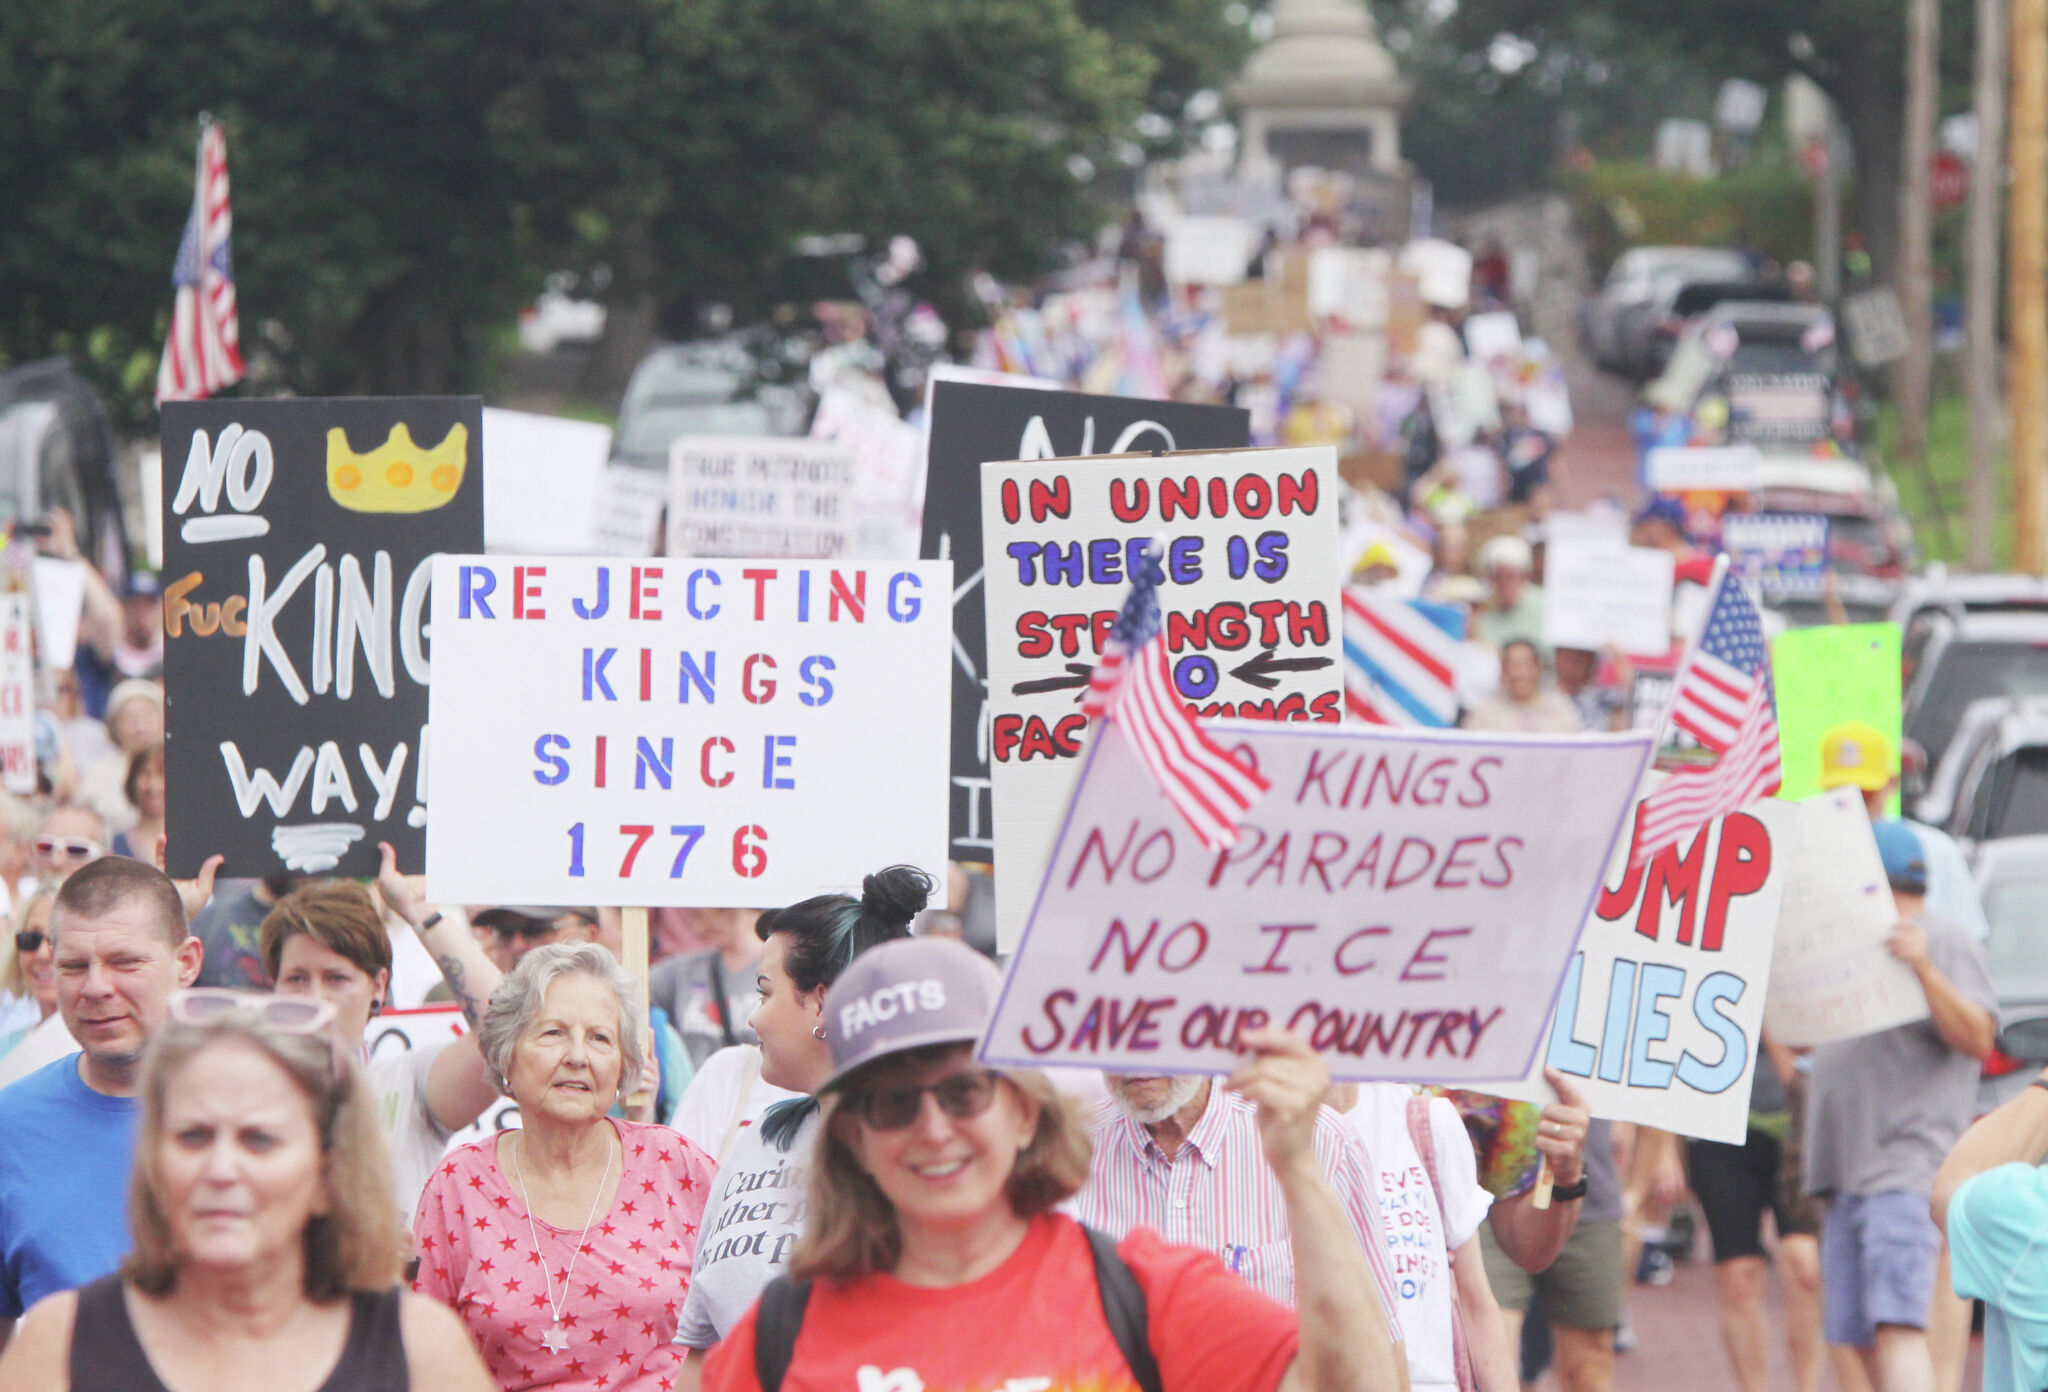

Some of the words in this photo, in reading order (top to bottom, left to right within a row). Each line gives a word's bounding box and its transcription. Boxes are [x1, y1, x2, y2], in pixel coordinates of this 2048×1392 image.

[172, 422, 274, 514] NO
[1001, 475, 1071, 524] IN
[1110, 468, 1319, 523] UNION
[1006, 535, 1204, 588] THERE
[1226, 530, 1289, 584] IS
[458, 564, 923, 623] REJECTING
[1015, 599, 1331, 660] STRNGTH
[582, 647, 836, 707] KINGS
[533, 733, 797, 790] SINCE
[993, 713, 1083, 763] FAC
[219, 724, 427, 829] WAY!
[1297, 750, 1503, 810] KINGS
[567, 822, 769, 879] 1776
[1066, 819, 1175, 890] NO
[1207, 828, 1525, 893] PARADES
[1595, 798, 1773, 952] UMP
[1090, 919, 1209, 975] NO
[841, 979, 947, 1040] FACTS
[1020, 989, 1177, 1055] SAVE
[1545, 950, 1749, 1094] LIES
[711, 1230, 770, 1265] not
